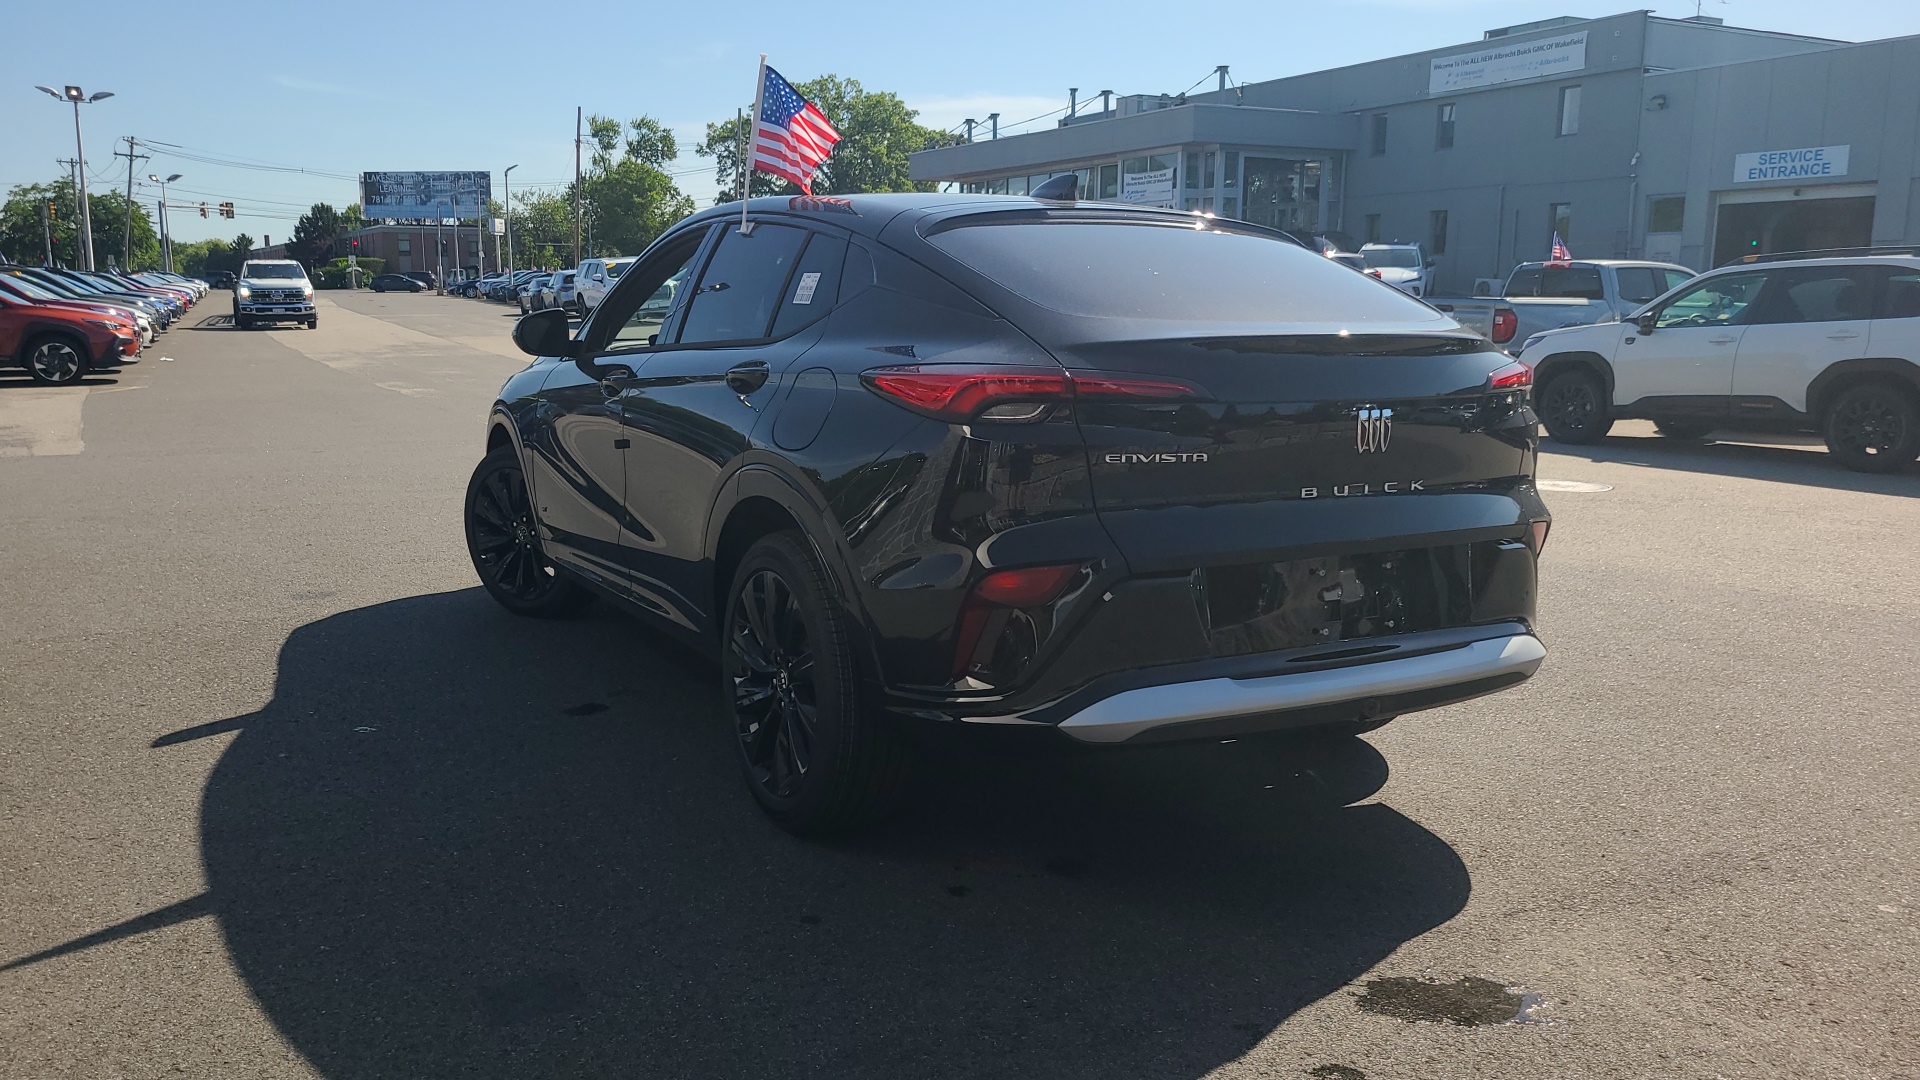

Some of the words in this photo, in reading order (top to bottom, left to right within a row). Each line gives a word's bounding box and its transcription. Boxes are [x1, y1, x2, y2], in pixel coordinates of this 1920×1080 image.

[1516, 46, 1532, 56] Buick
[1532, 44, 1546, 53] GMC
[1554, 37, 1584, 49] Wakefield
[1539, 56, 1570, 66] Albrecht
[1758, 149, 1825, 166] SERVICE
[1748, 162, 1832, 180] ENTRANCE
[1105, 453, 1208, 463] ENVISTA
[1301, 479, 1425, 499] BUICK
